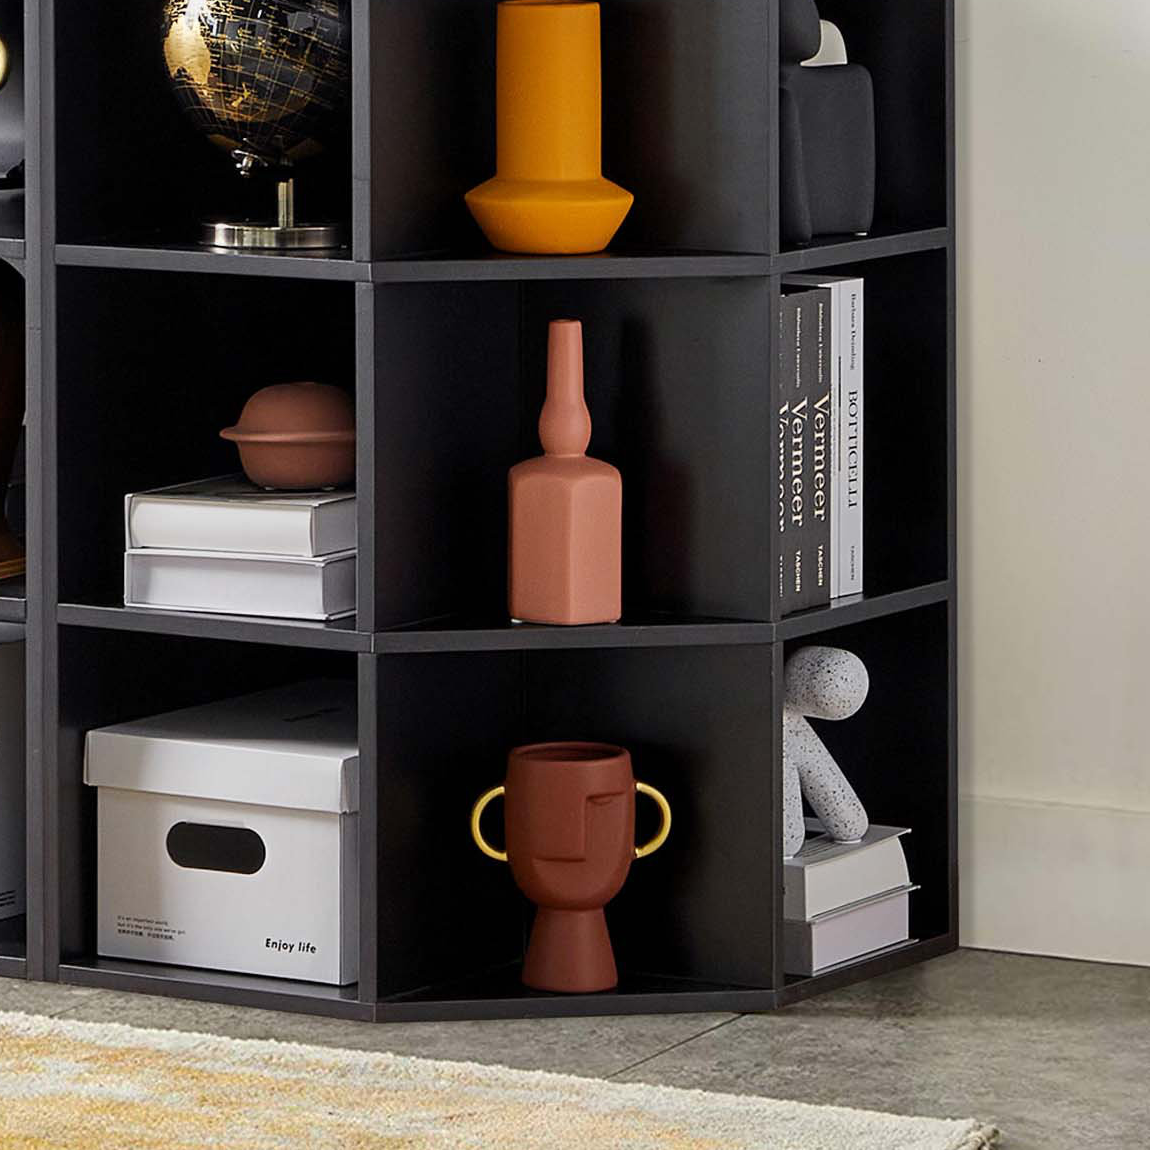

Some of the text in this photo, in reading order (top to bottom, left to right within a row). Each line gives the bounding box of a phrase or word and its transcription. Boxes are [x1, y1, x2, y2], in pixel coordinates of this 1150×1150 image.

[792, 397, 808, 527] Vermeer
[814, 392, 830, 521] Vermeer
[848, 389, 858, 508] BOTTICELLI
[265, 938, 317, 954] Enjoy life
